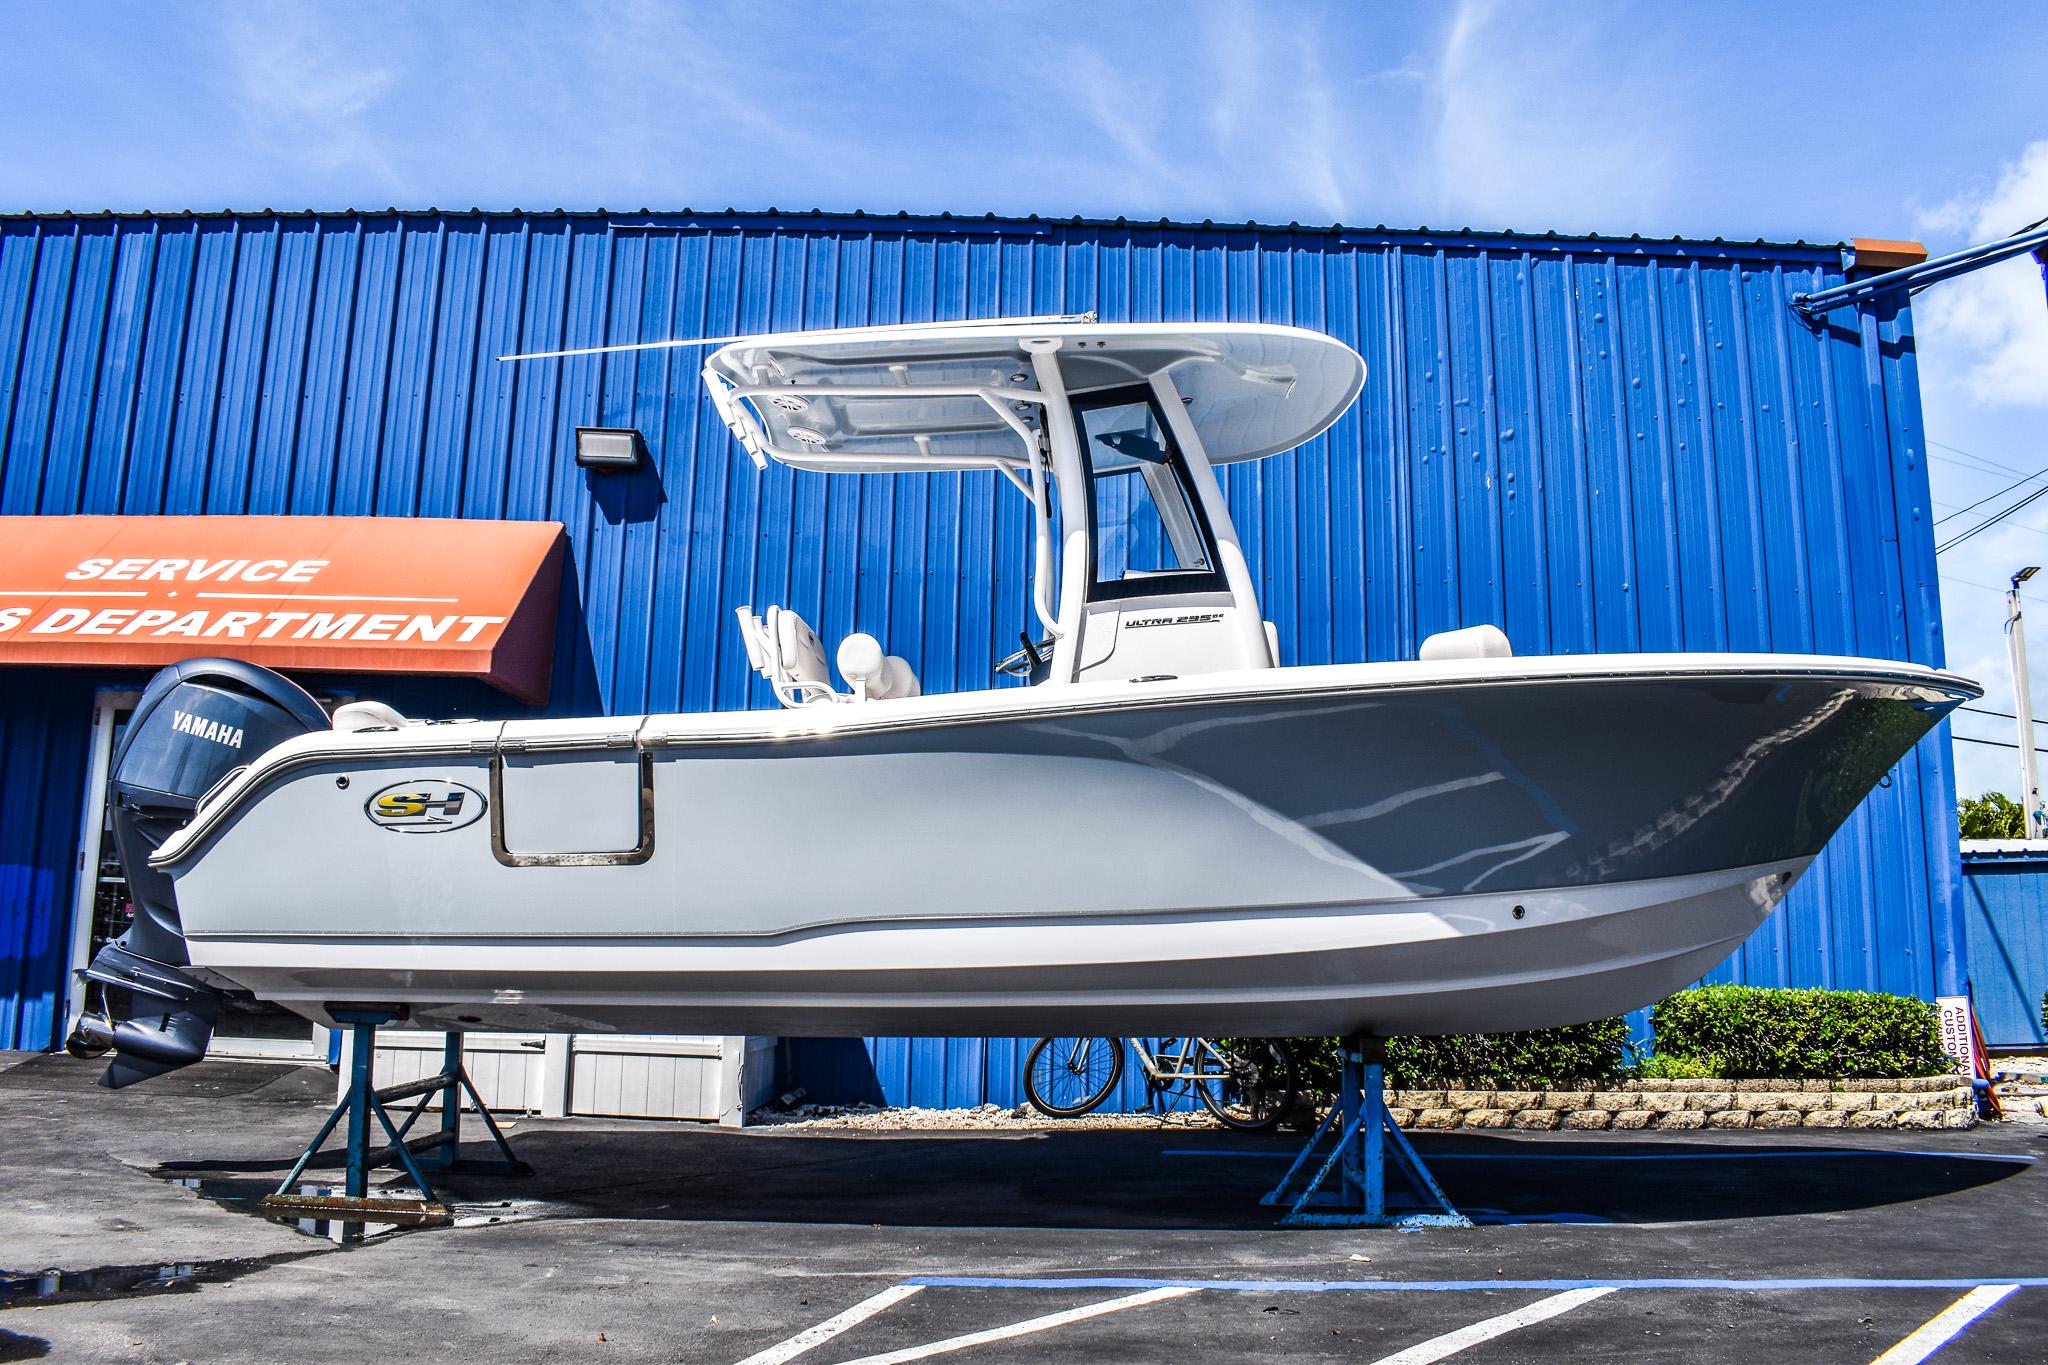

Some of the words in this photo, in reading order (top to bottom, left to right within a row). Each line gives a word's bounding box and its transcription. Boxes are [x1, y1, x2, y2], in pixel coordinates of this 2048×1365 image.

[64, 558, 331, 583] SERVICE
[28, 608, 507, 642] DEPARTMENT
[1125, 617, 1173, 628] ULTRA
[172, 710, 244, 749] YAMAHA
[374, 791, 465, 817] SH
[1955, 1006, 1971, 1076] ADDITIONAL
